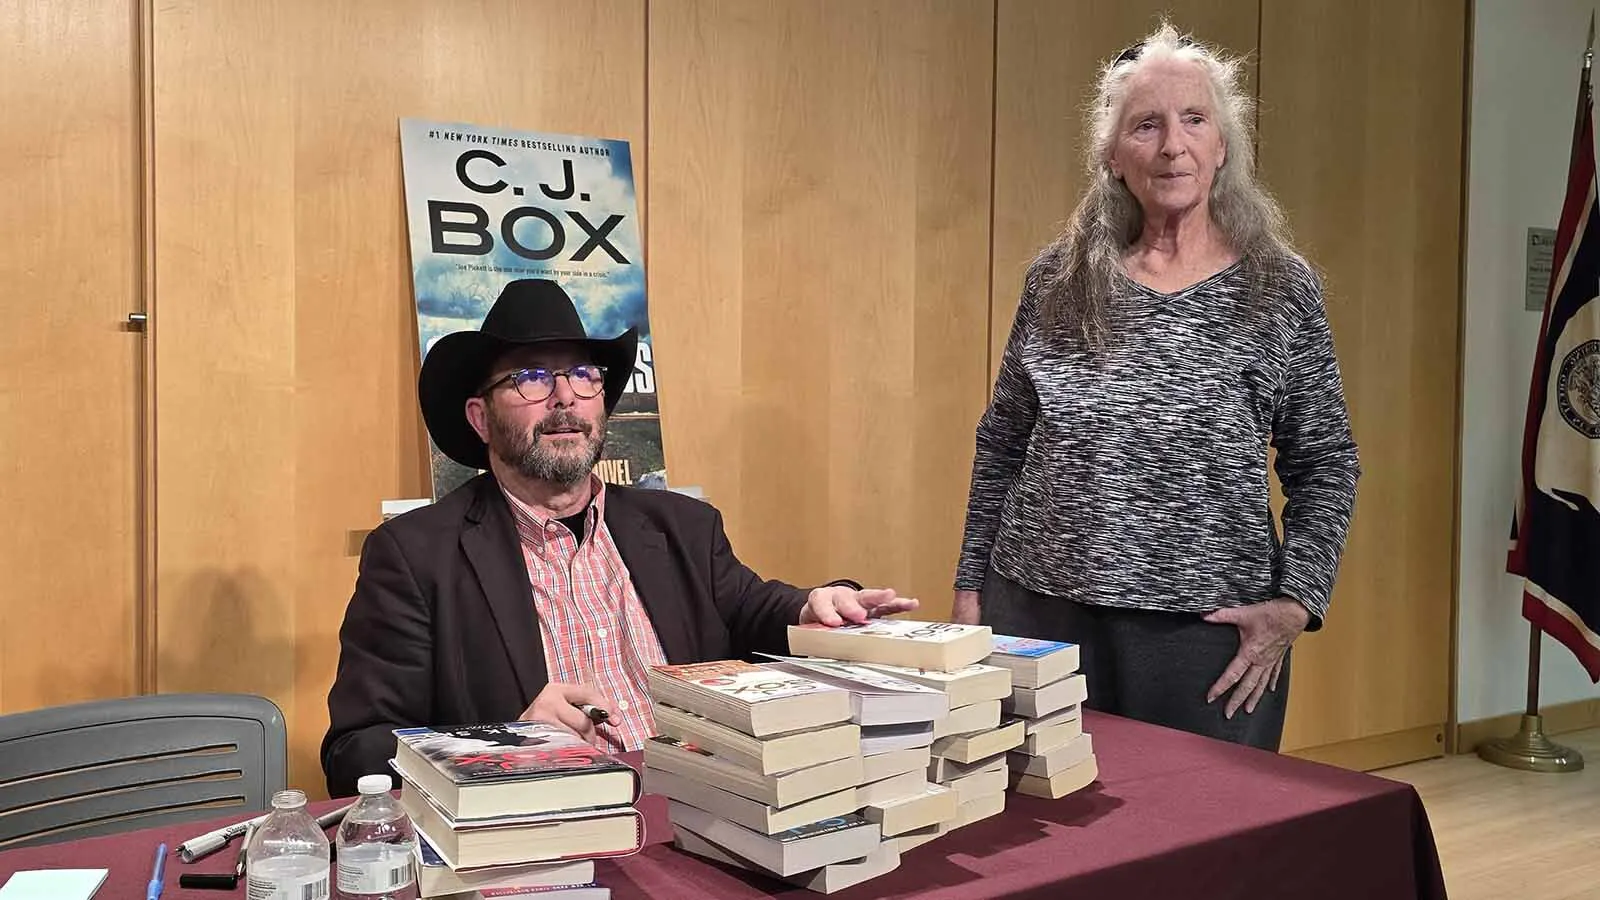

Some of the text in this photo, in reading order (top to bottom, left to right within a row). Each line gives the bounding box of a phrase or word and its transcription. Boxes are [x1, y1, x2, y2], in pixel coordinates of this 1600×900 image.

[429, 131, 610, 156] #1 NEW YORK TIMES BESTSELLING AUTHOR
[455, 149, 591, 202] C. J.
[427, 199, 631, 265] BOX
